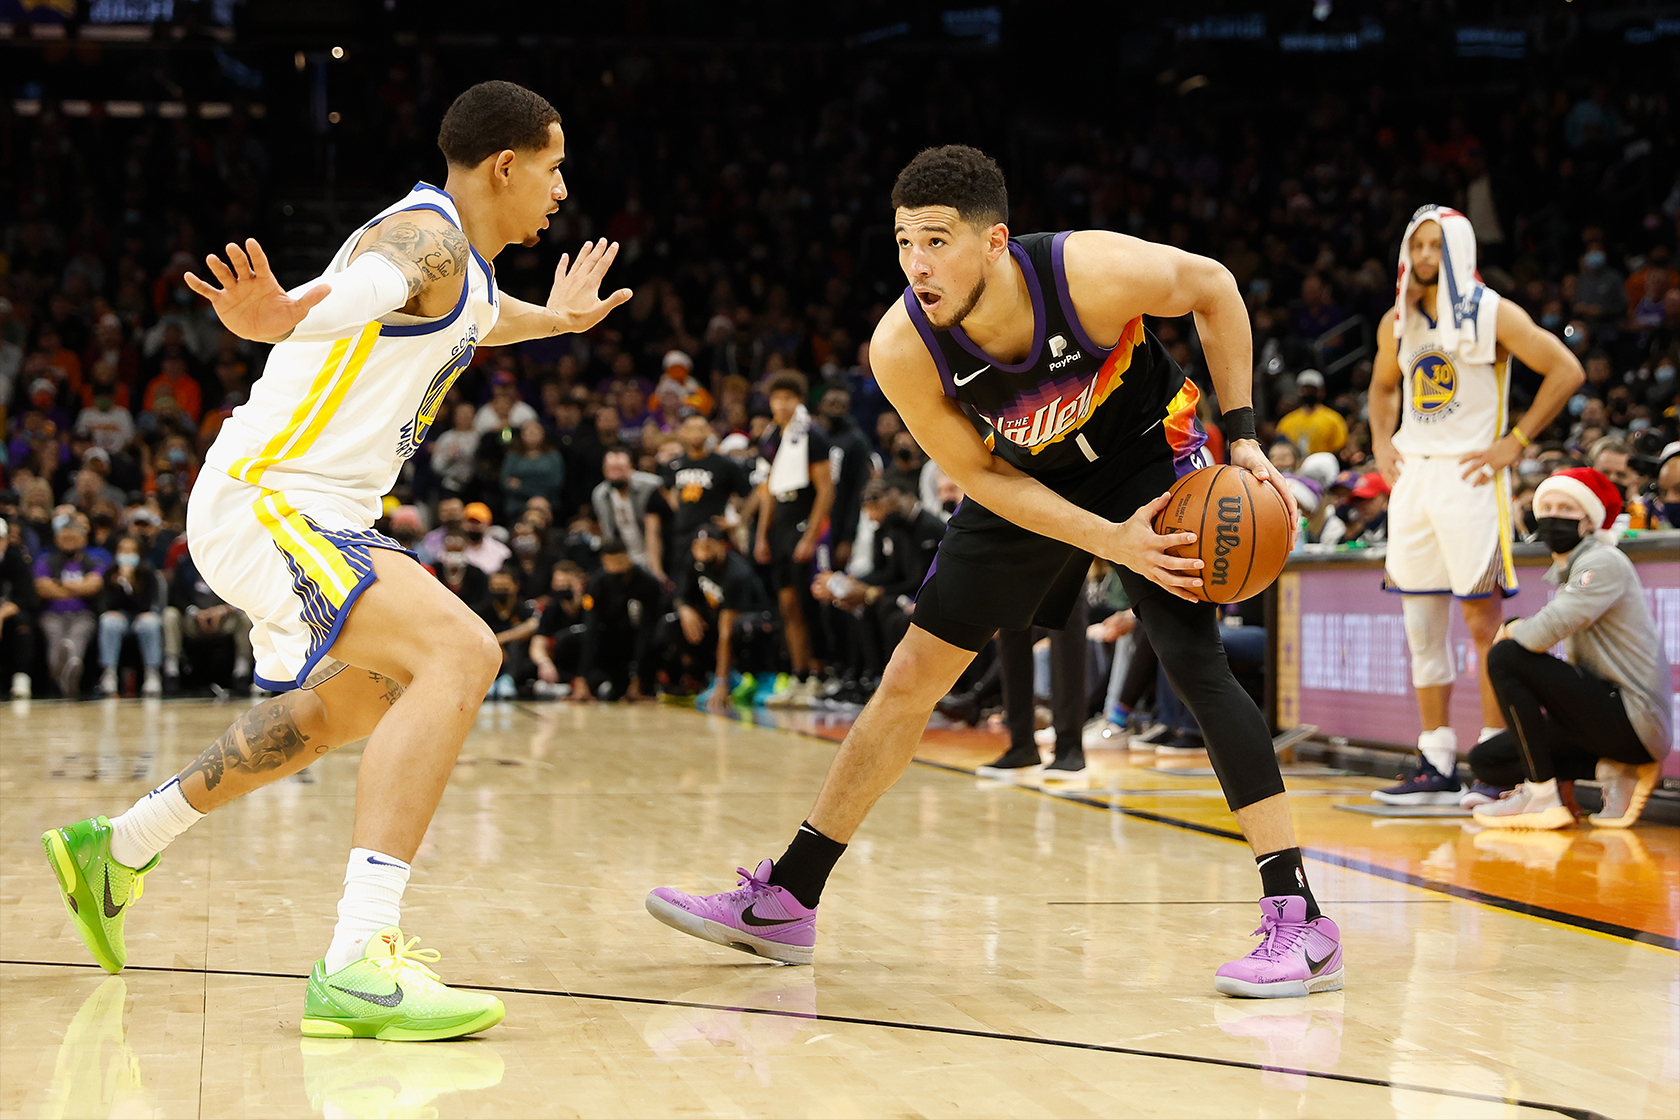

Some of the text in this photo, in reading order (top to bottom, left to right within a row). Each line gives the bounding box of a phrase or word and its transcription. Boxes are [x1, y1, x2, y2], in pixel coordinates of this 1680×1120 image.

[1049, 351, 1082, 372] PayPal
[1431, 364, 1452, 385] 30
[1006, 416, 1030, 428] THE
[1075, 432, 1100, 462] 1
[1211, 495, 1242, 586] Wilson
